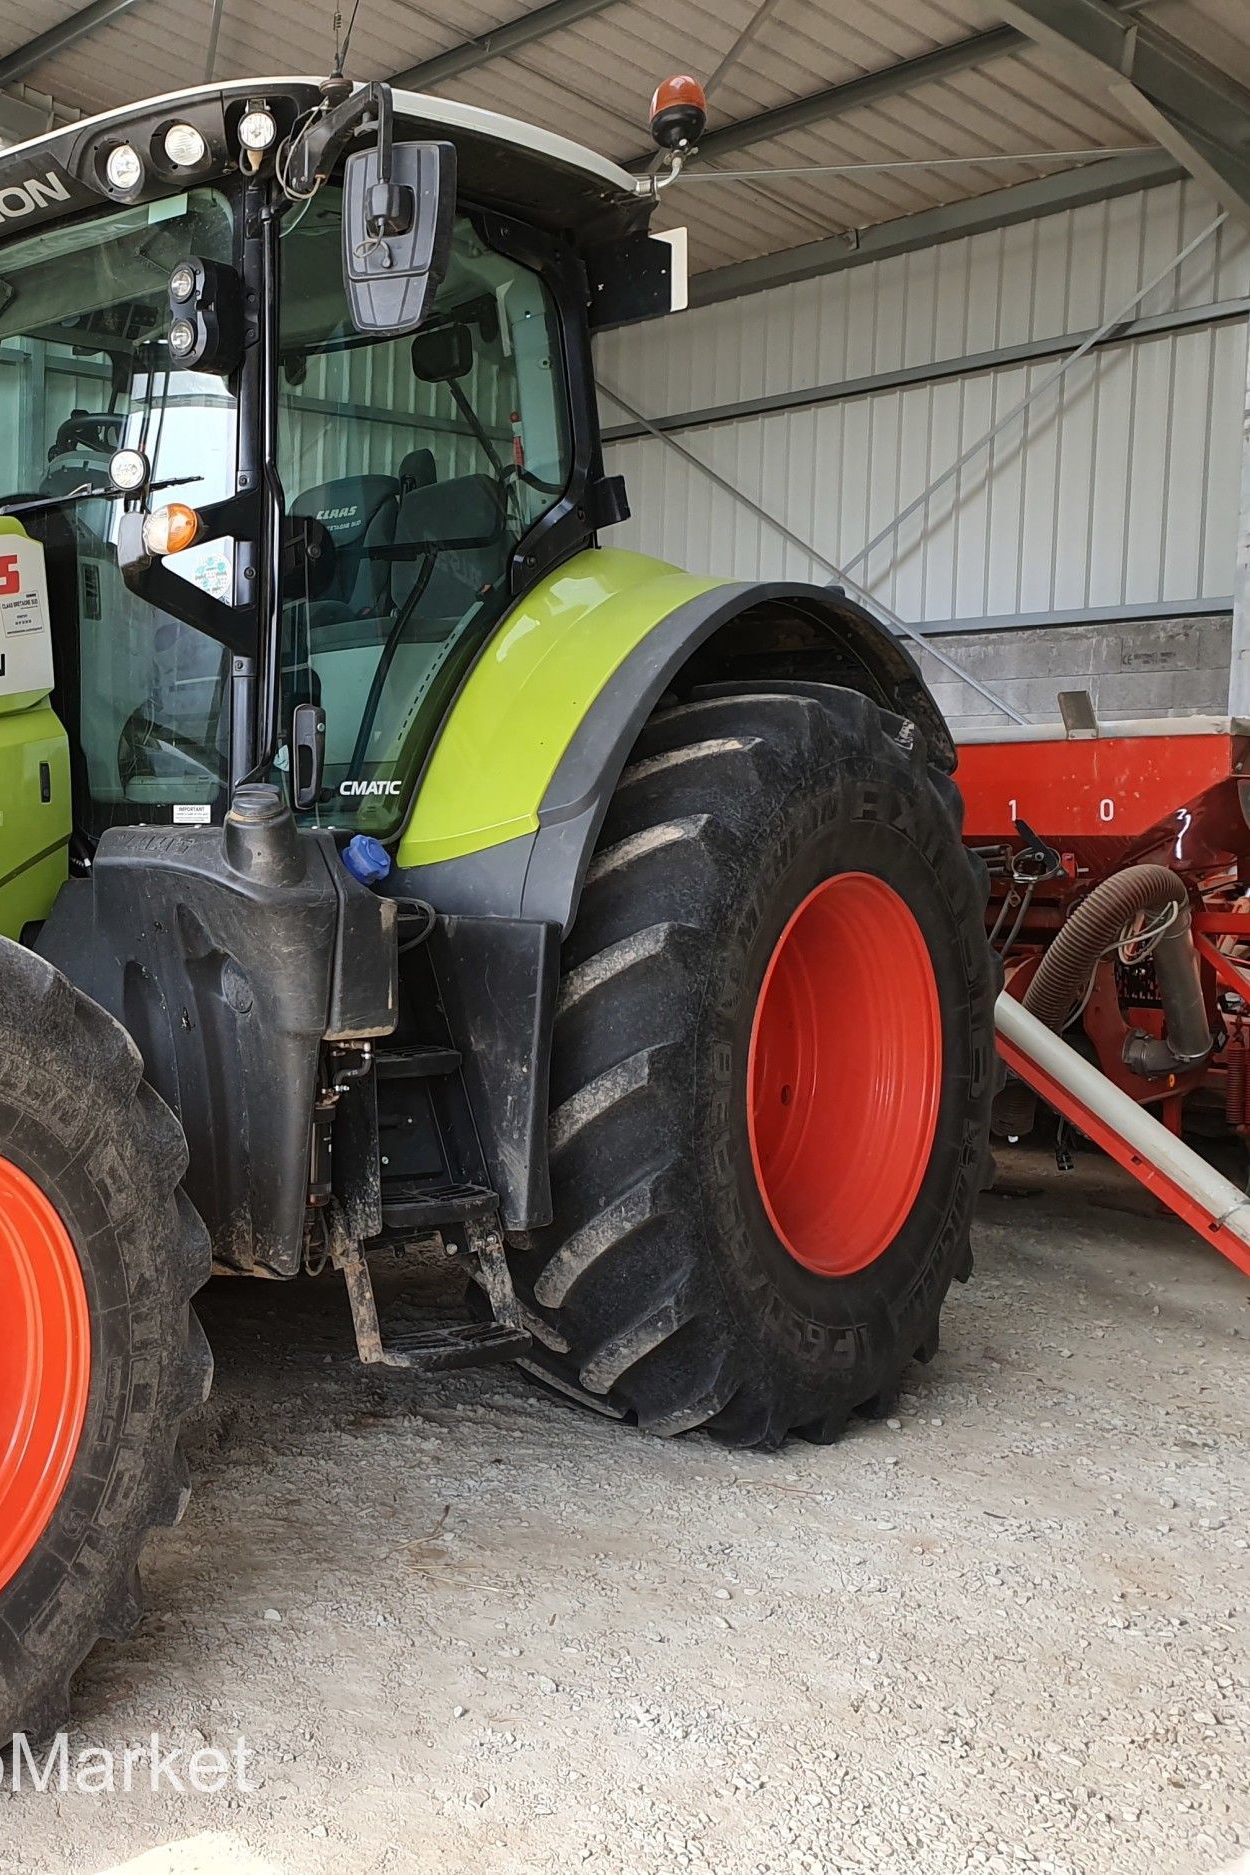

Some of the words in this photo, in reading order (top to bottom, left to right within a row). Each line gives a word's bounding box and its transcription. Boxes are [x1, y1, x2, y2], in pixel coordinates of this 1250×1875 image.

[316, 506, 357, 520] CLAAS
[340, 781, 402, 796] CMATIC
[1008, 800, 1017, 821] 1
[1100, 799, 1114, 821] 0
